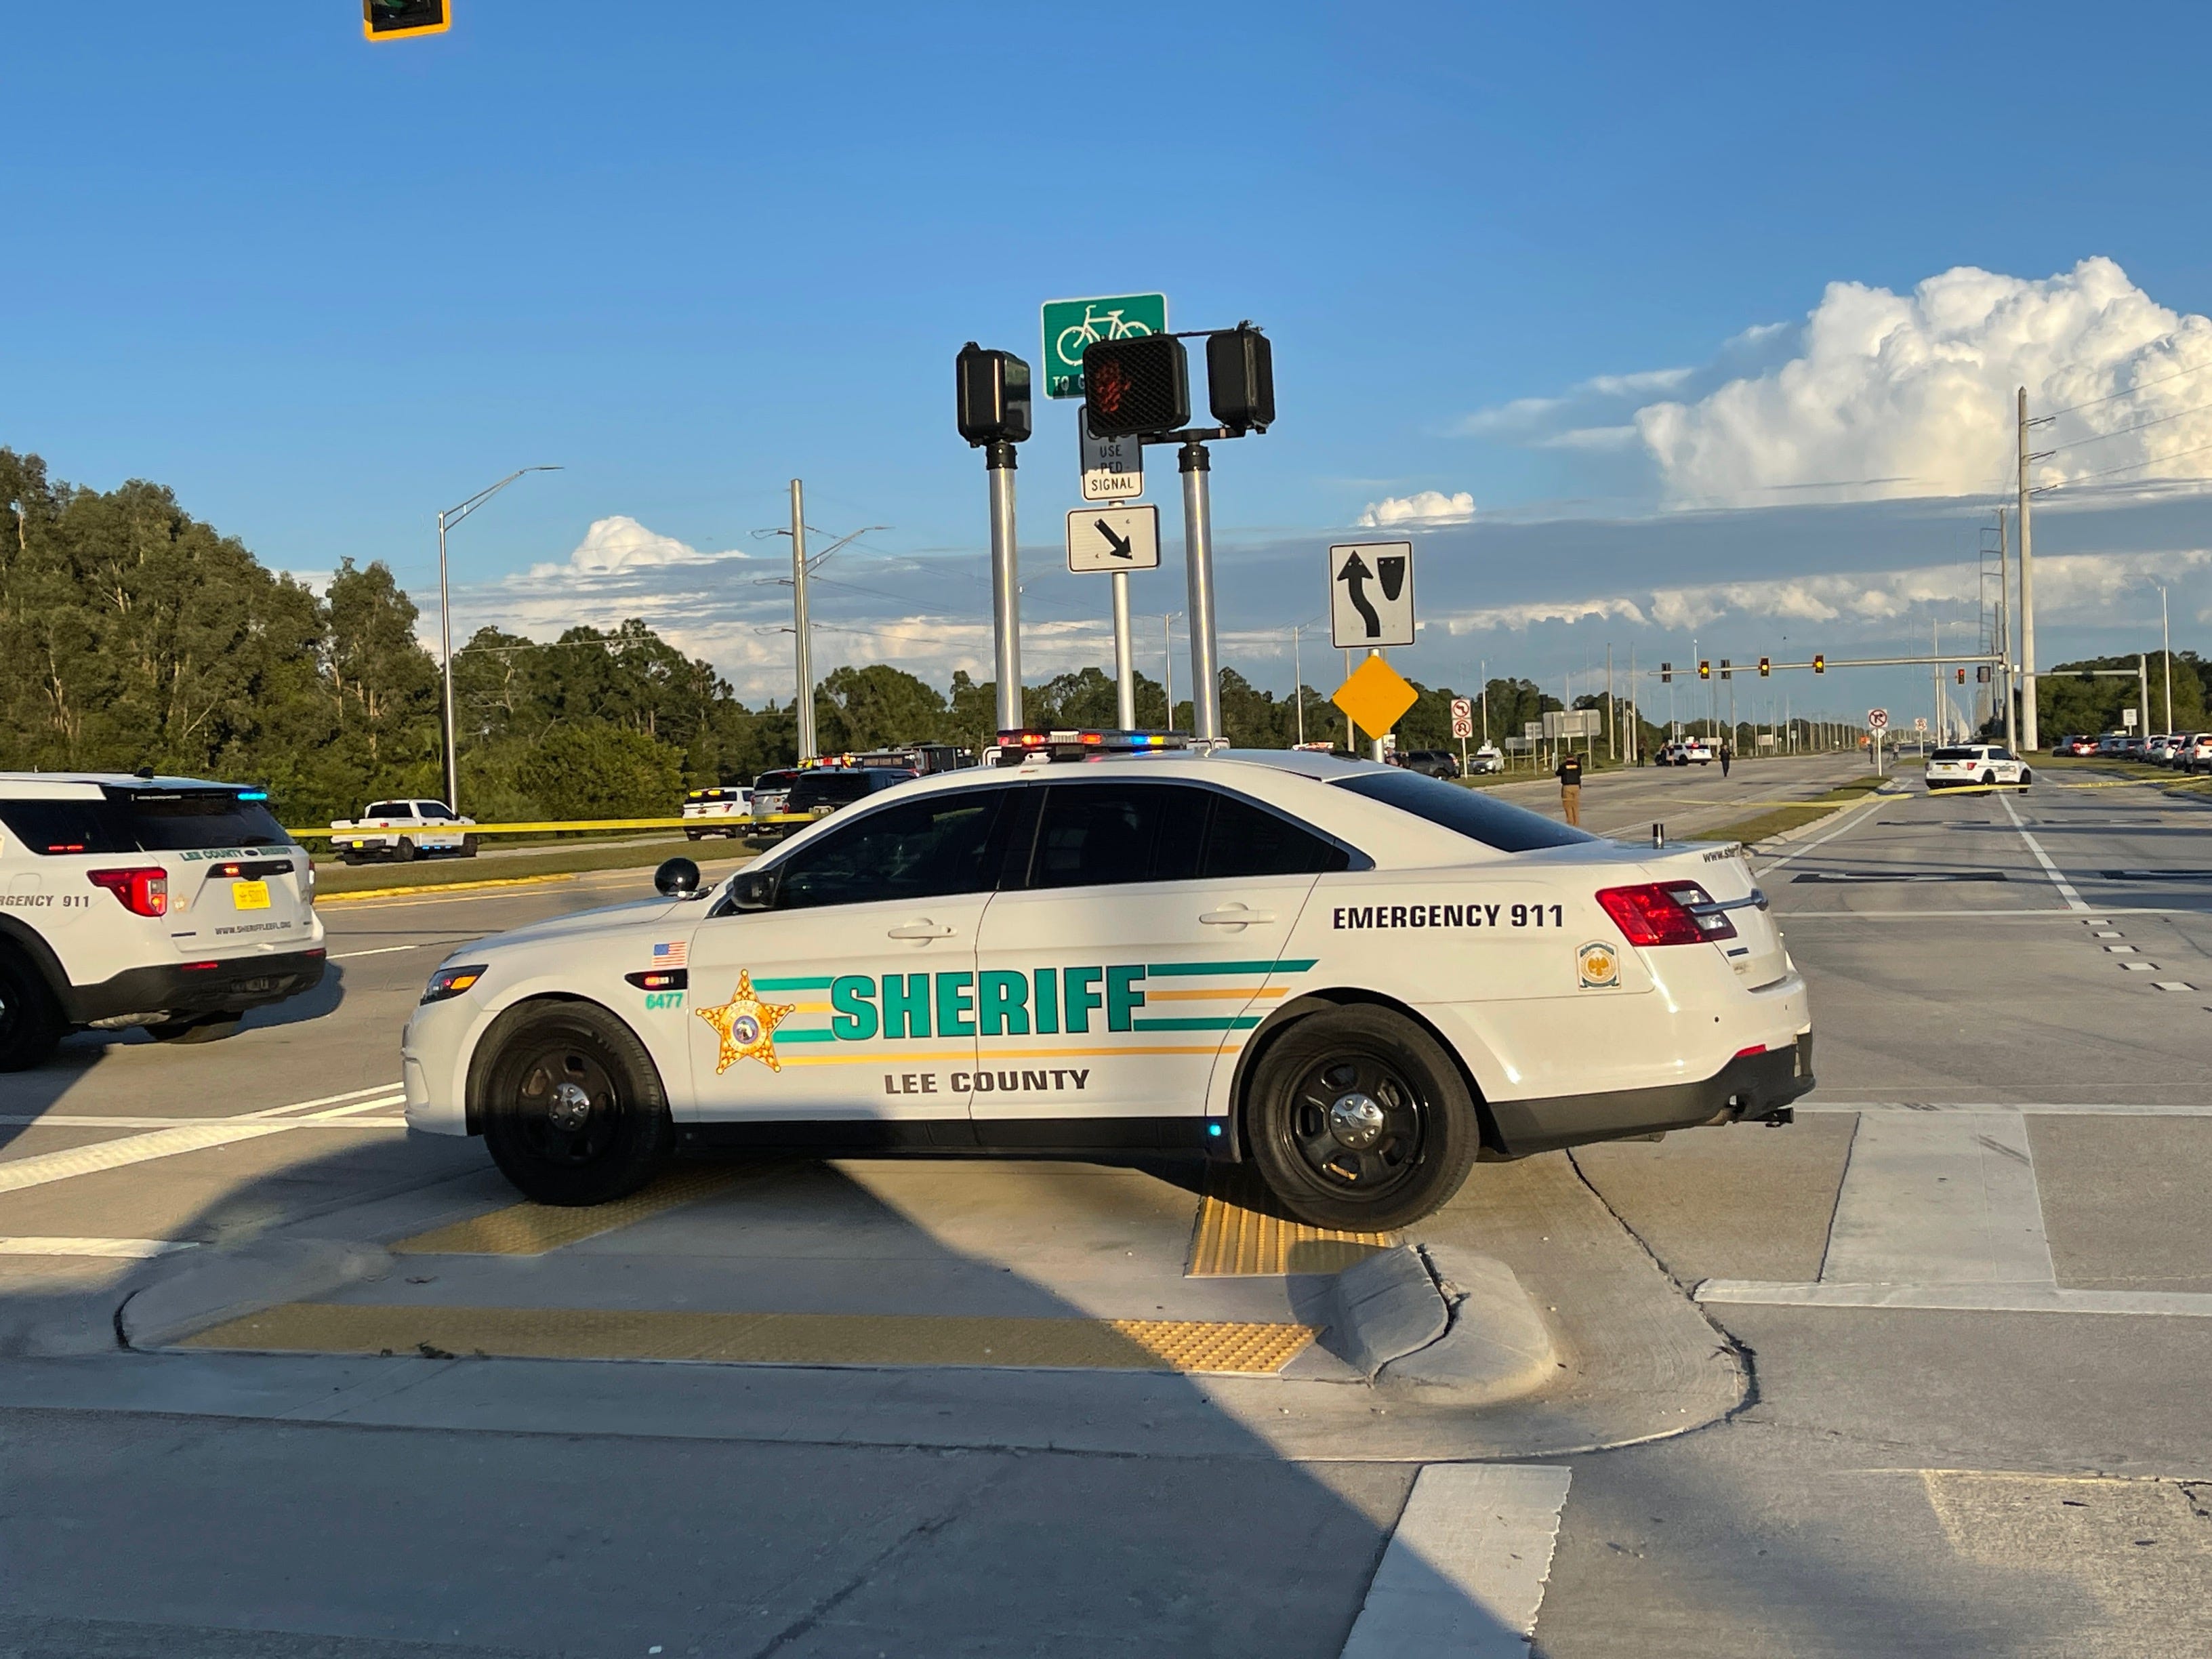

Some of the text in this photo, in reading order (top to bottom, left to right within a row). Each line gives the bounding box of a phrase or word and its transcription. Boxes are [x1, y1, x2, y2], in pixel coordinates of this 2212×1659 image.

[1100, 445, 1122, 457] USE
[1101, 461, 1122, 474] PED
[1092, 476, 1134, 491] SIGNAL
[204, 849, 244, 859] COUNTY
[62, 895, 89, 907] 911
[1333, 903, 1563, 930] EMERGENCY 911
[645, 992, 683, 1010] 6477
[831, 964, 1145, 1040] SHERIFF
[884, 1069, 1090, 1094] LEE COUNTY
